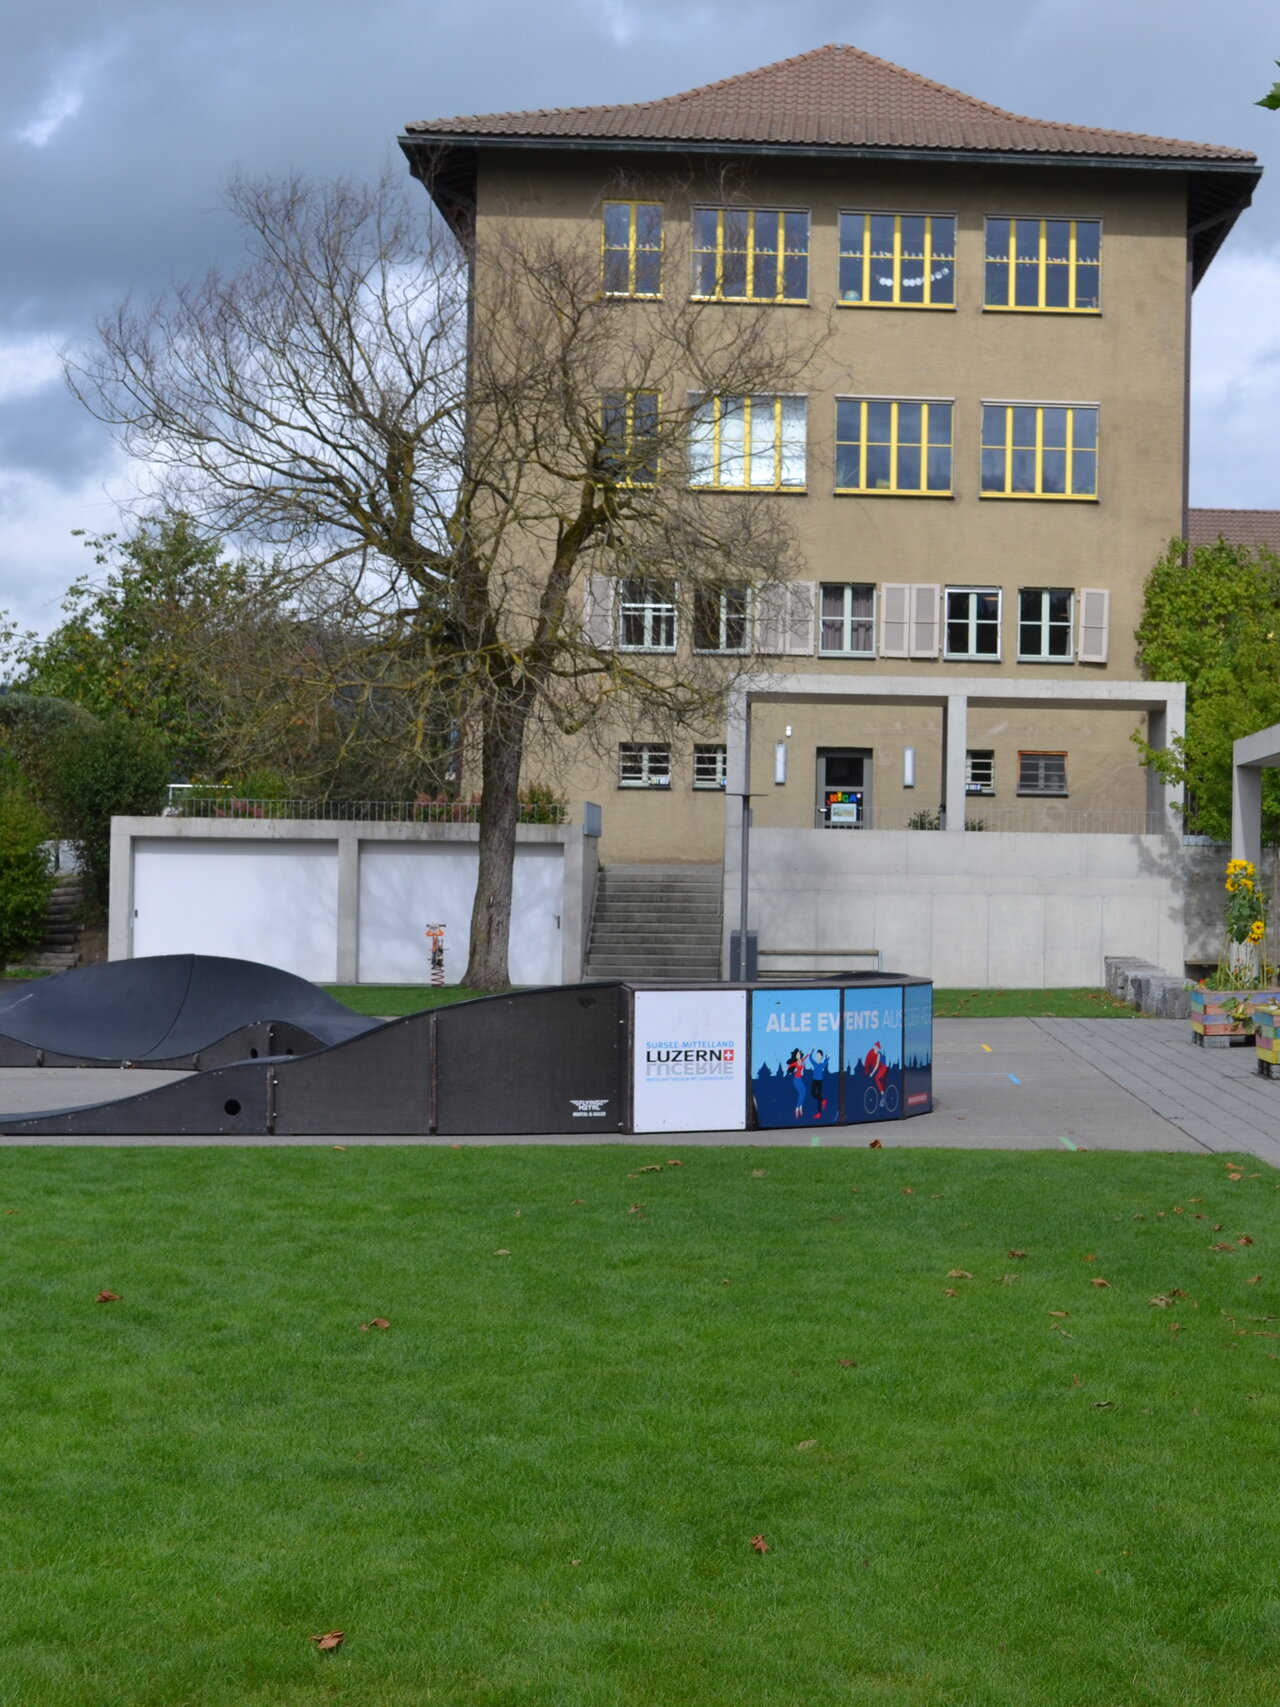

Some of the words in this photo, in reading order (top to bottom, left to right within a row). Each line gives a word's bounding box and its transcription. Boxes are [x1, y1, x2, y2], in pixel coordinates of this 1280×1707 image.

[829, 791, 857, 803] KIGA
[766, 1012, 811, 1032] ALLE
[817, 1010, 879, 1031] EVENTS
[646, 1041, 734, 1049] SURSEE-MITTELLAND
[646, 1050, 722, 1062] LUZERN
